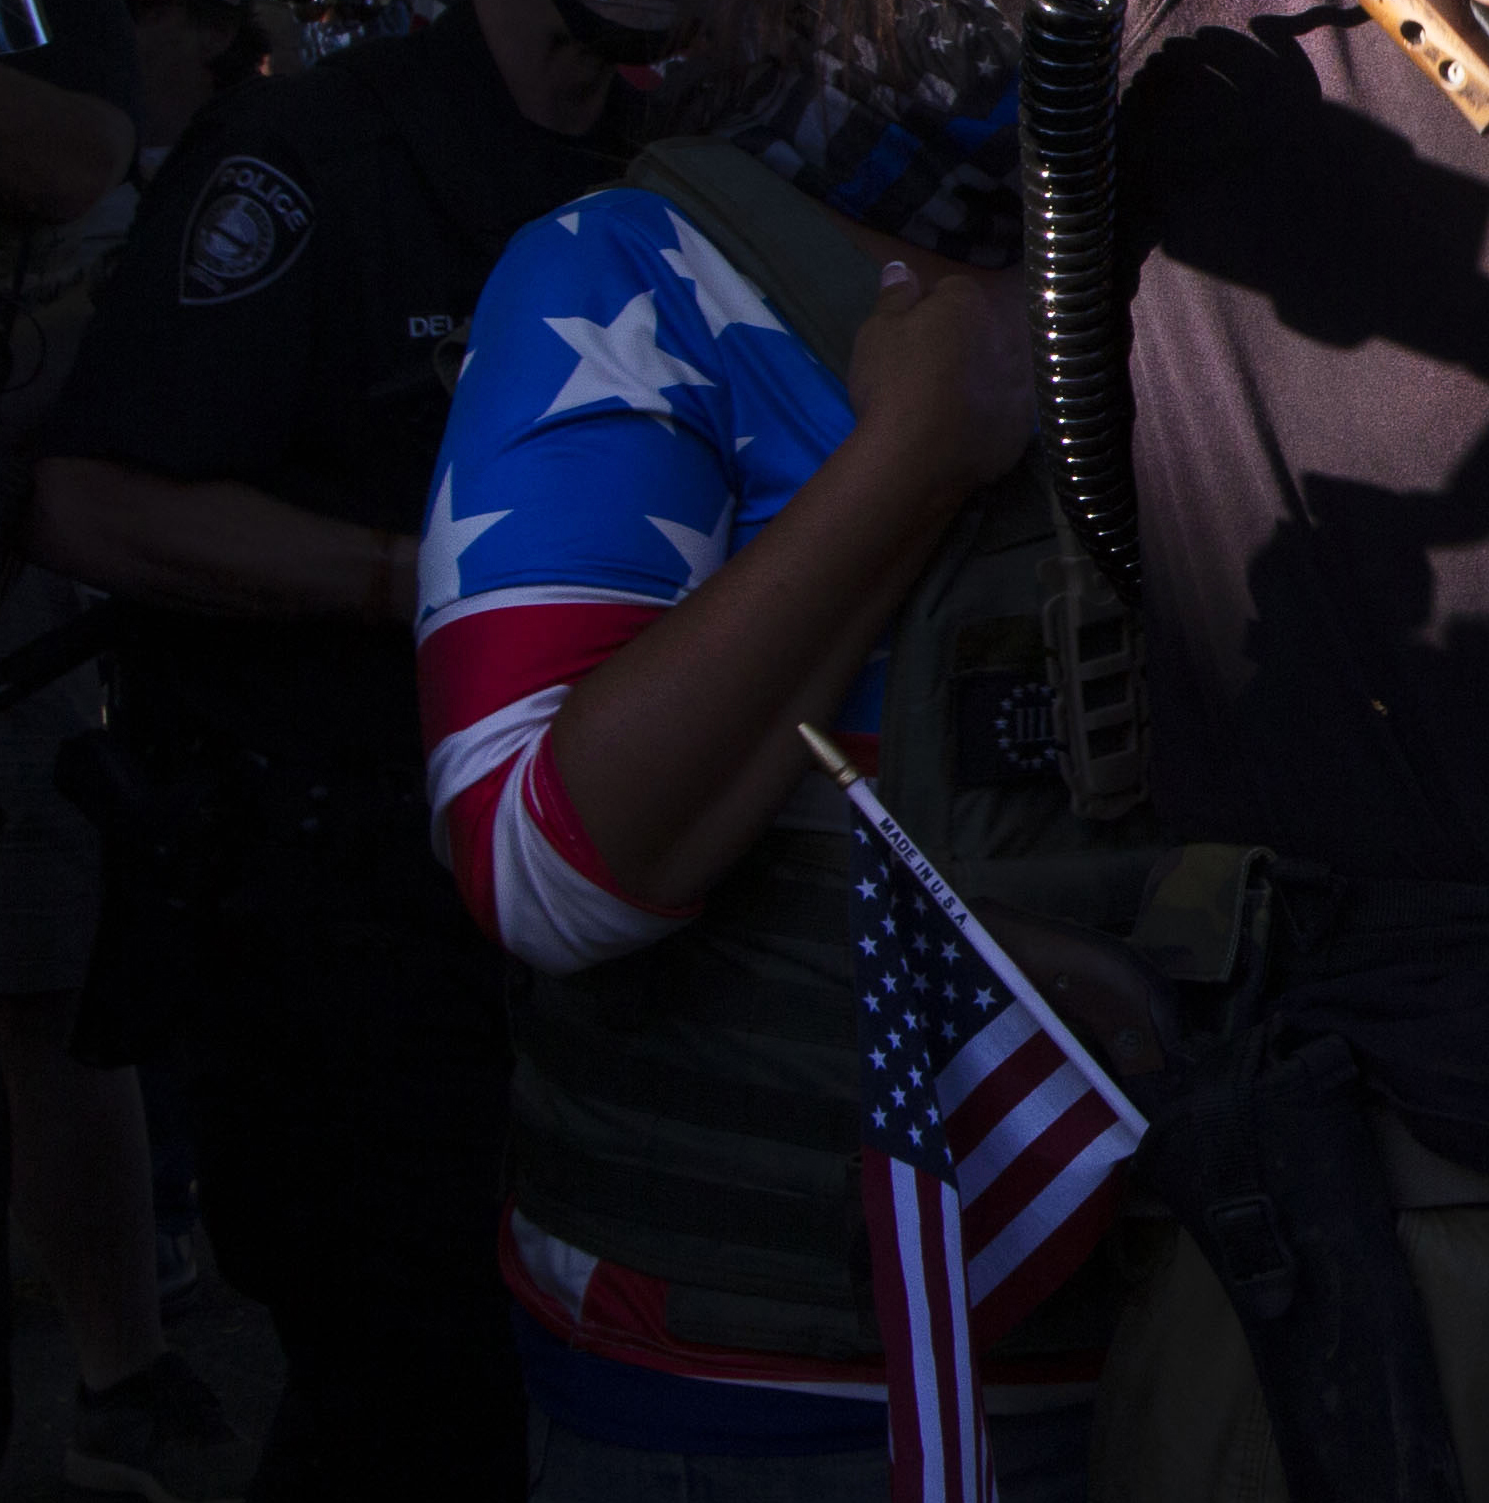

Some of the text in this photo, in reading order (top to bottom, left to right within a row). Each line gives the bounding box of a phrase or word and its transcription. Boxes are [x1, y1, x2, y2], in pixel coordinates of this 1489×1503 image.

[880, 817, 967, 930] MADE IN U.S.A.
